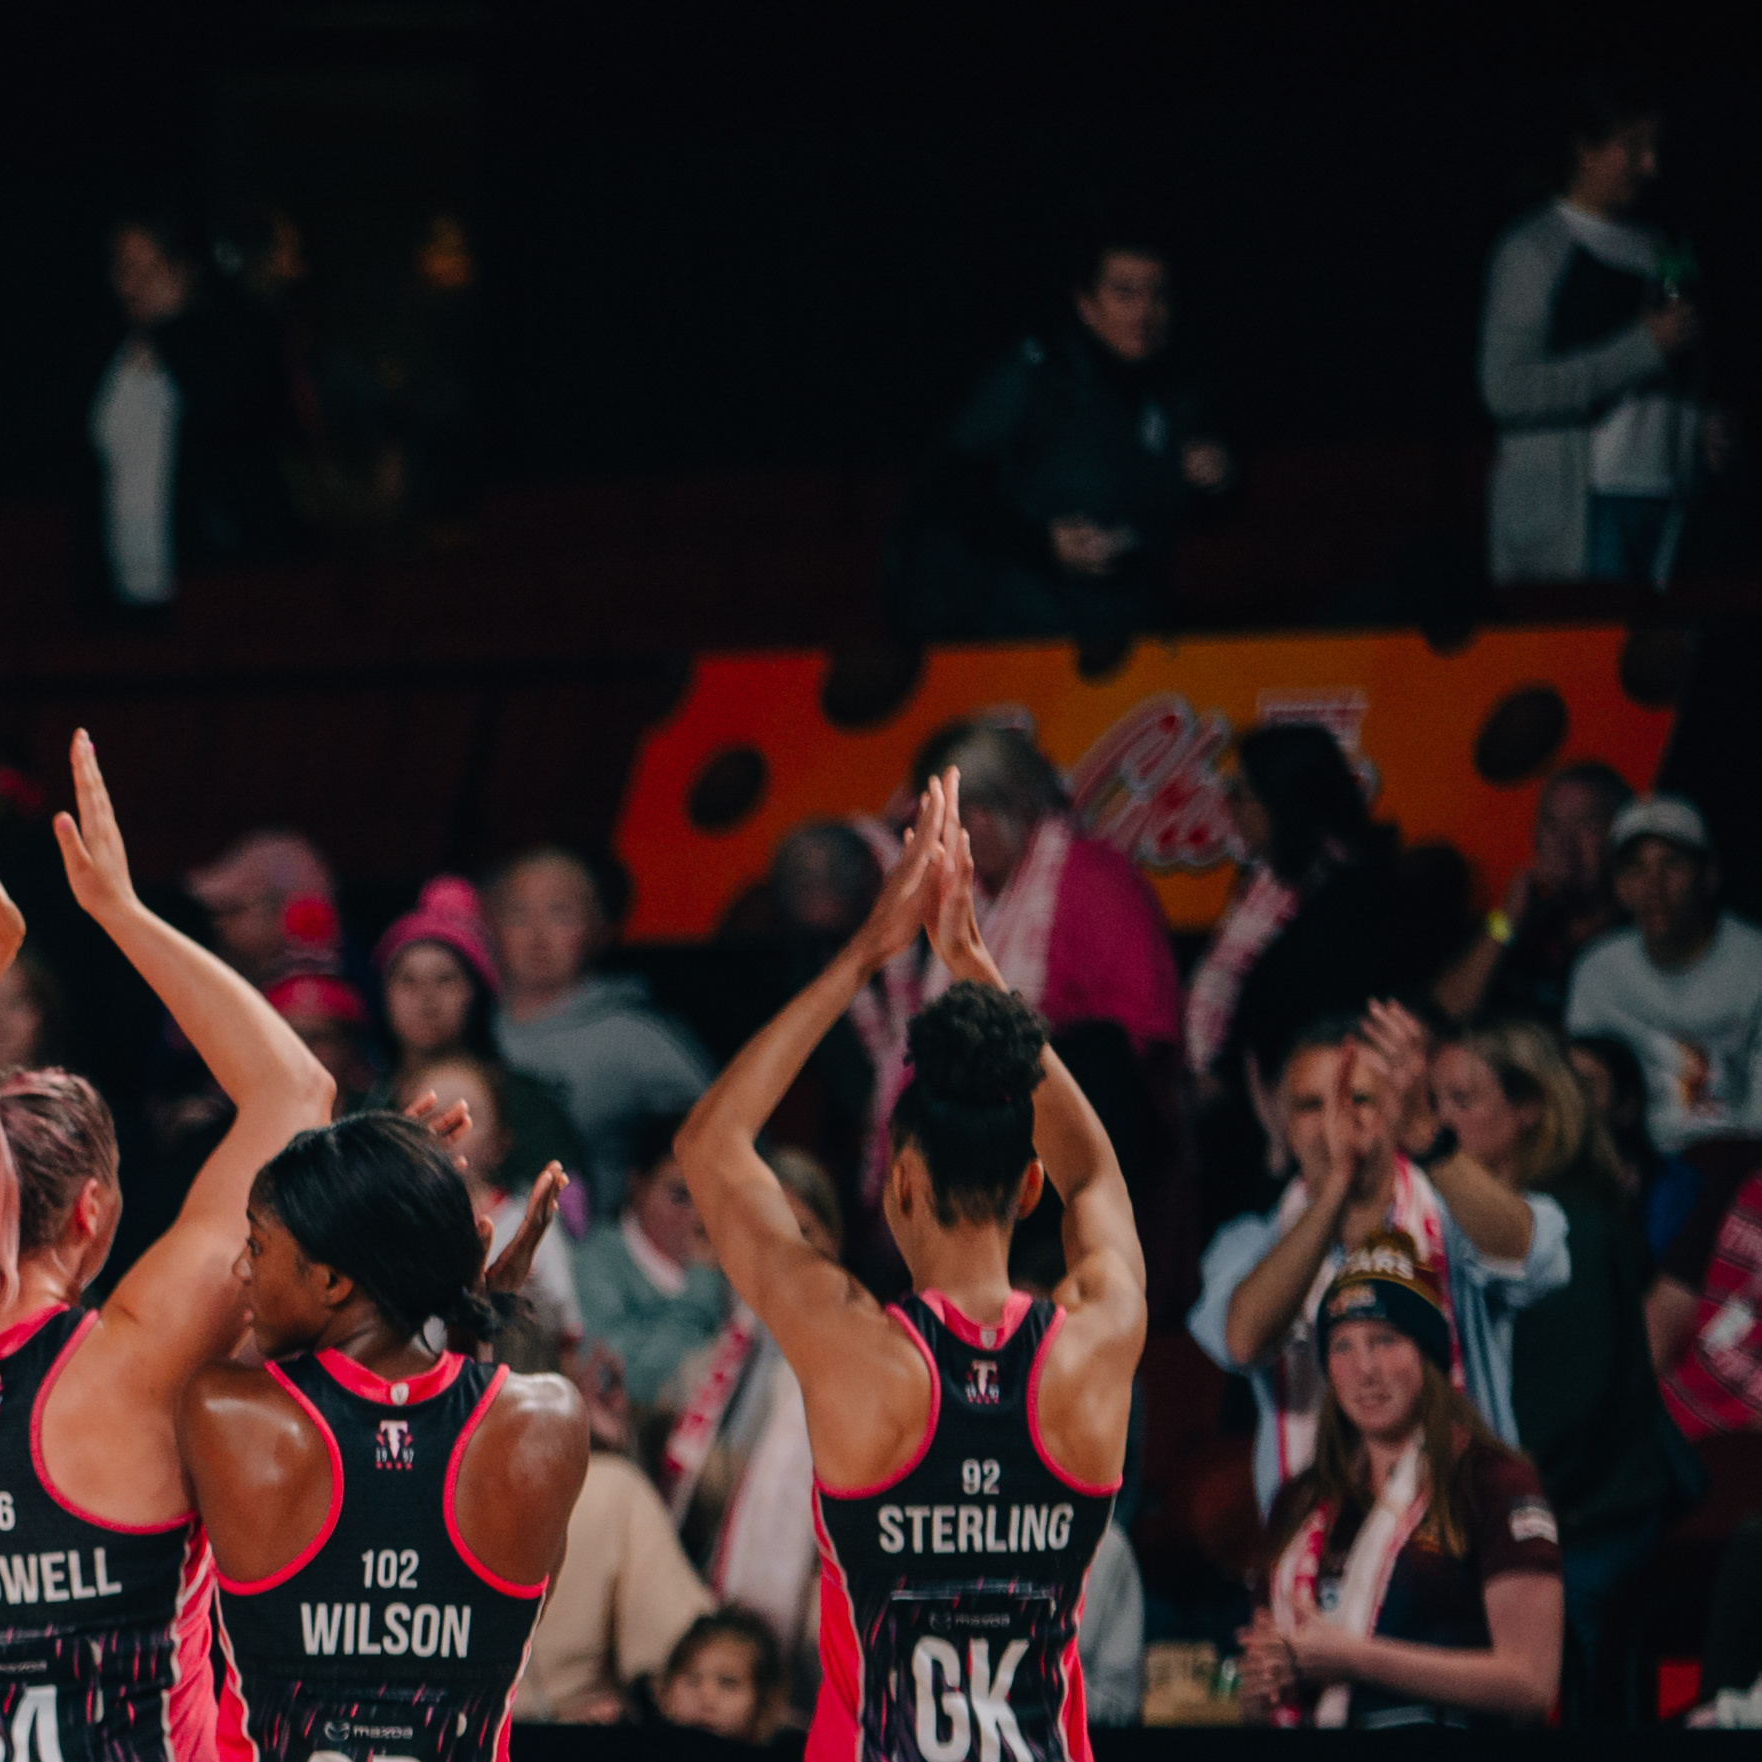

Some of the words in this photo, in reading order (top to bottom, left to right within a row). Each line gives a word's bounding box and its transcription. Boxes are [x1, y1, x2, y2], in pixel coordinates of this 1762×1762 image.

[962, 1458, 1001, 1495] 92
[878, 1503, 1075, 1554] STERLING
[361, 1549, 420, 1589] 102
[300, 1602, 471, 1658] WILSON
